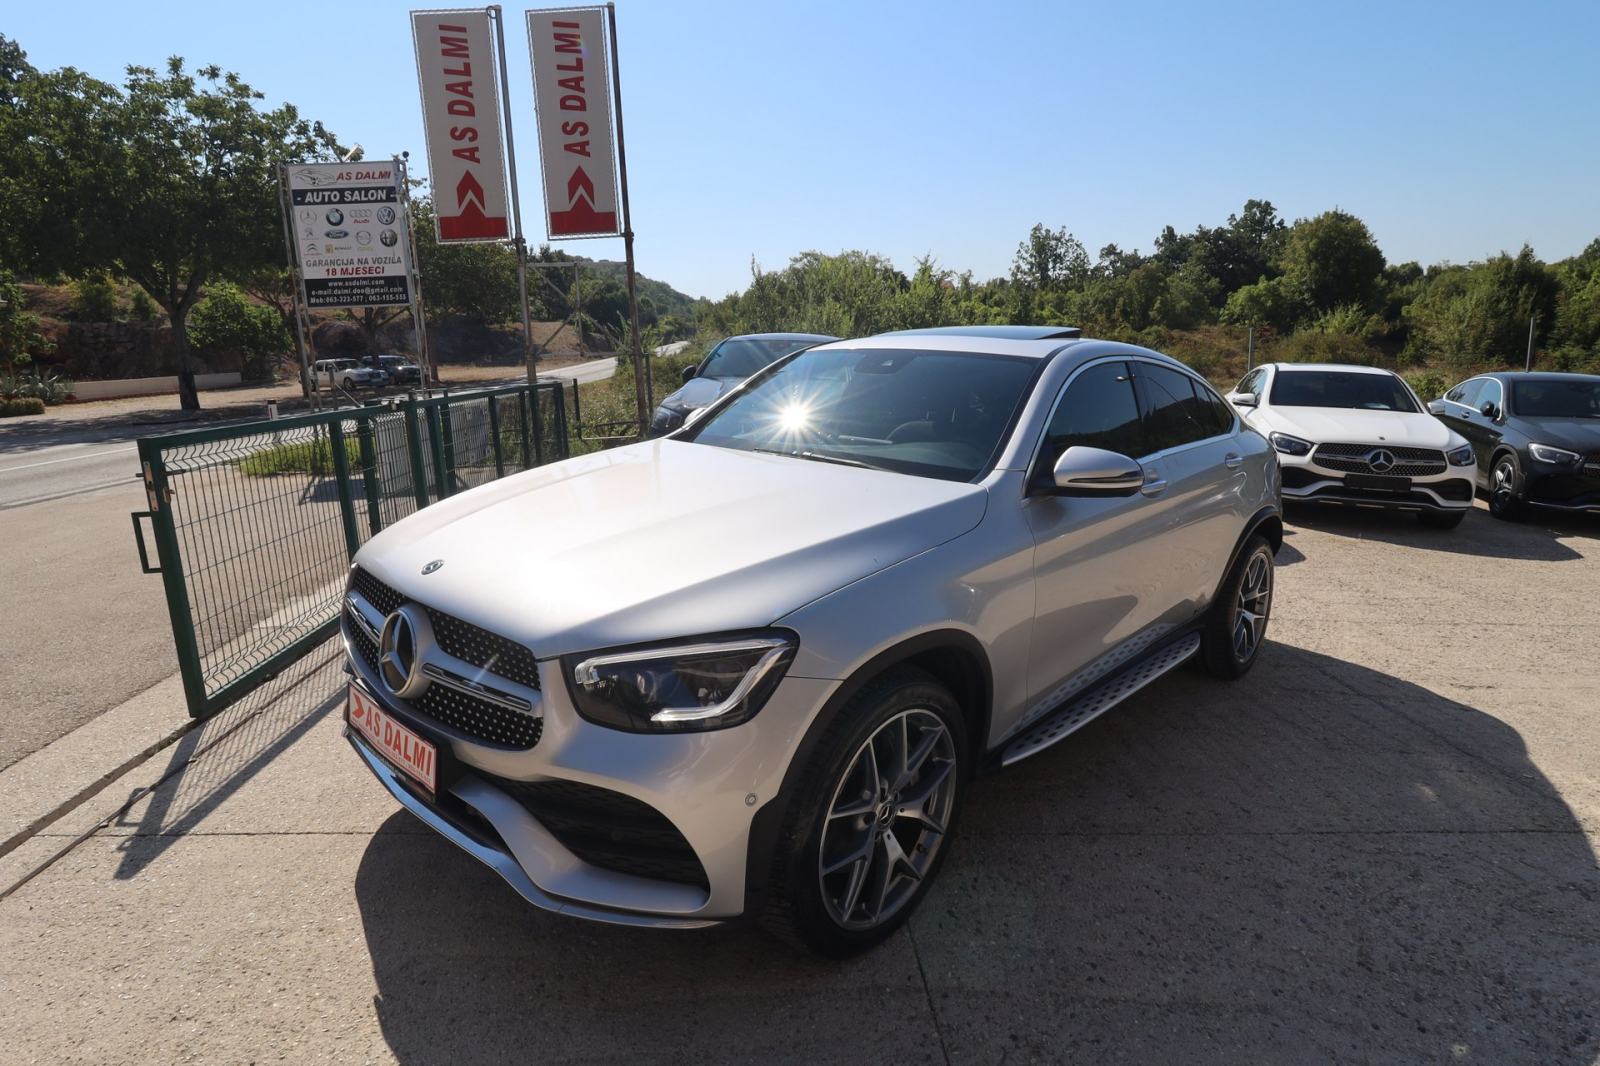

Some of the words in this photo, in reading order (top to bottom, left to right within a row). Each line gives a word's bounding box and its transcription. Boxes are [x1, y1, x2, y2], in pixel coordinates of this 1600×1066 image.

[438, 24, 476, 118] DALMI
[552, 21, 587, 112] DALMI
[451, 126, 480, 164] AS
[562, 121, 591, 158] AS
[336, 171, 353, 181] AS
[355, 170, 392, 180] DALMI
[304, 191, 340, 203] AUTO
[343, 189, 387, 201] SALON
[306, 259, 355, 267] GARANCIJA
[357, 257, 370, 265] NA
[372, 256, 402, 265] VOZILA
[325, 268, 337, 276] 18
[340, 266, 385, 276] MJESECI
[365, 706, 381, 738] AS
[384, 720, 433, 777] DALMI
